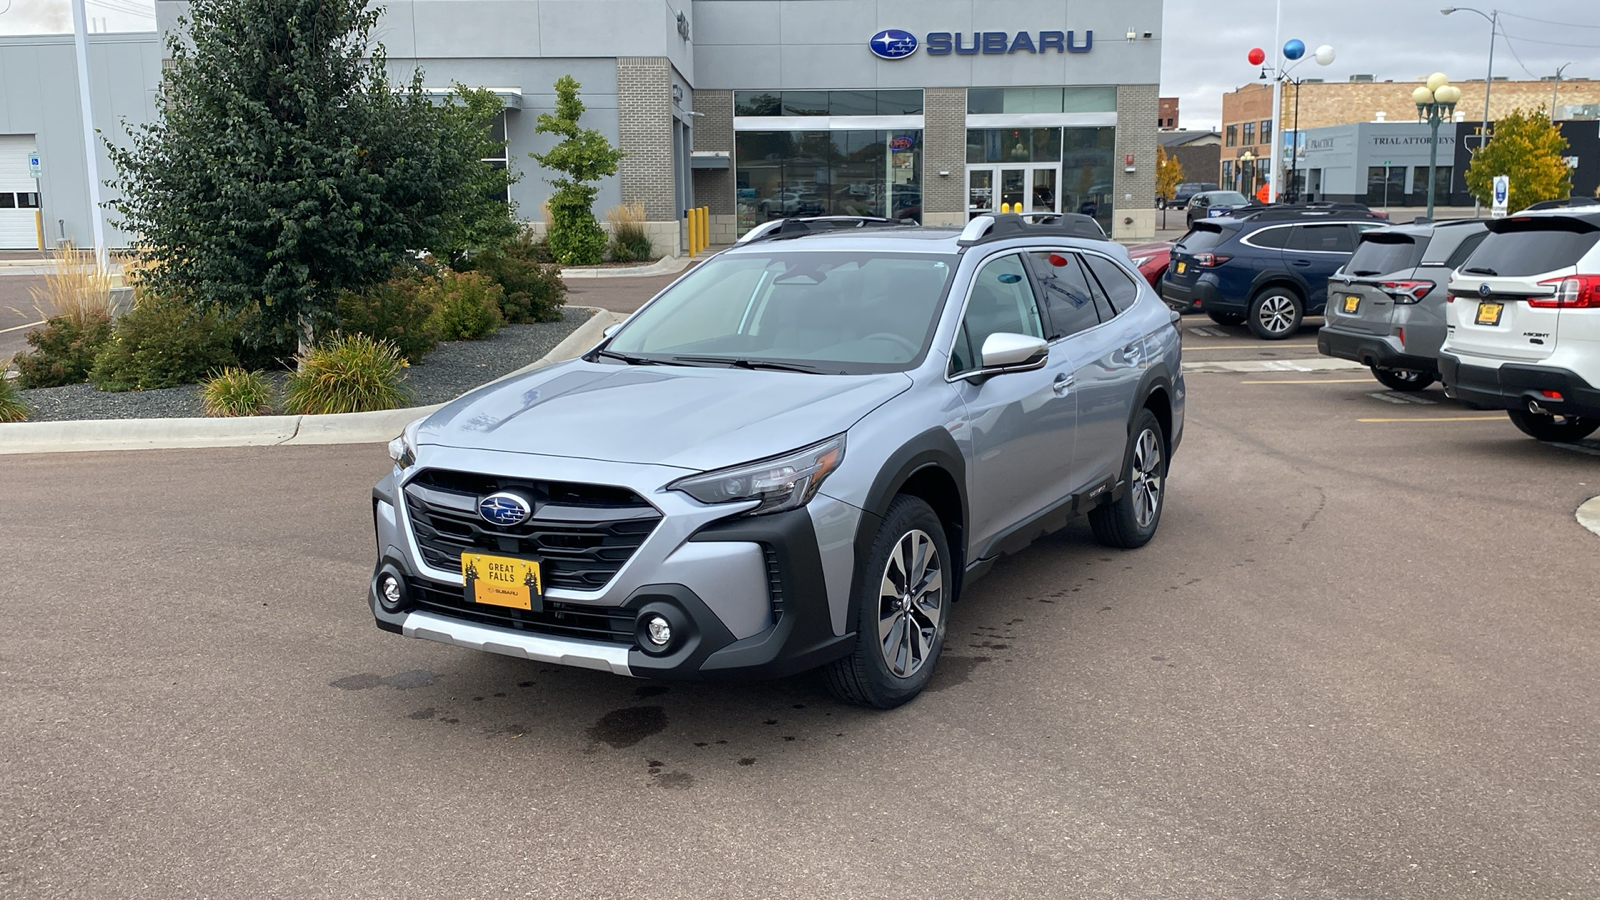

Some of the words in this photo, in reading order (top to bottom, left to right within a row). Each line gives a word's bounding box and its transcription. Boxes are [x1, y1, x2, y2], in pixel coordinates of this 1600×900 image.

[926, 30, 1093, 55] SUBARU
[890, 138, 910, 148] OPEN
[1373, 137, 1401, 145] TRIAL
[1402, 137, 1455, 145] ATTOREYS
[489, 562, 514, 573] GREAT
[489, 571, 515, 582] FALLS
